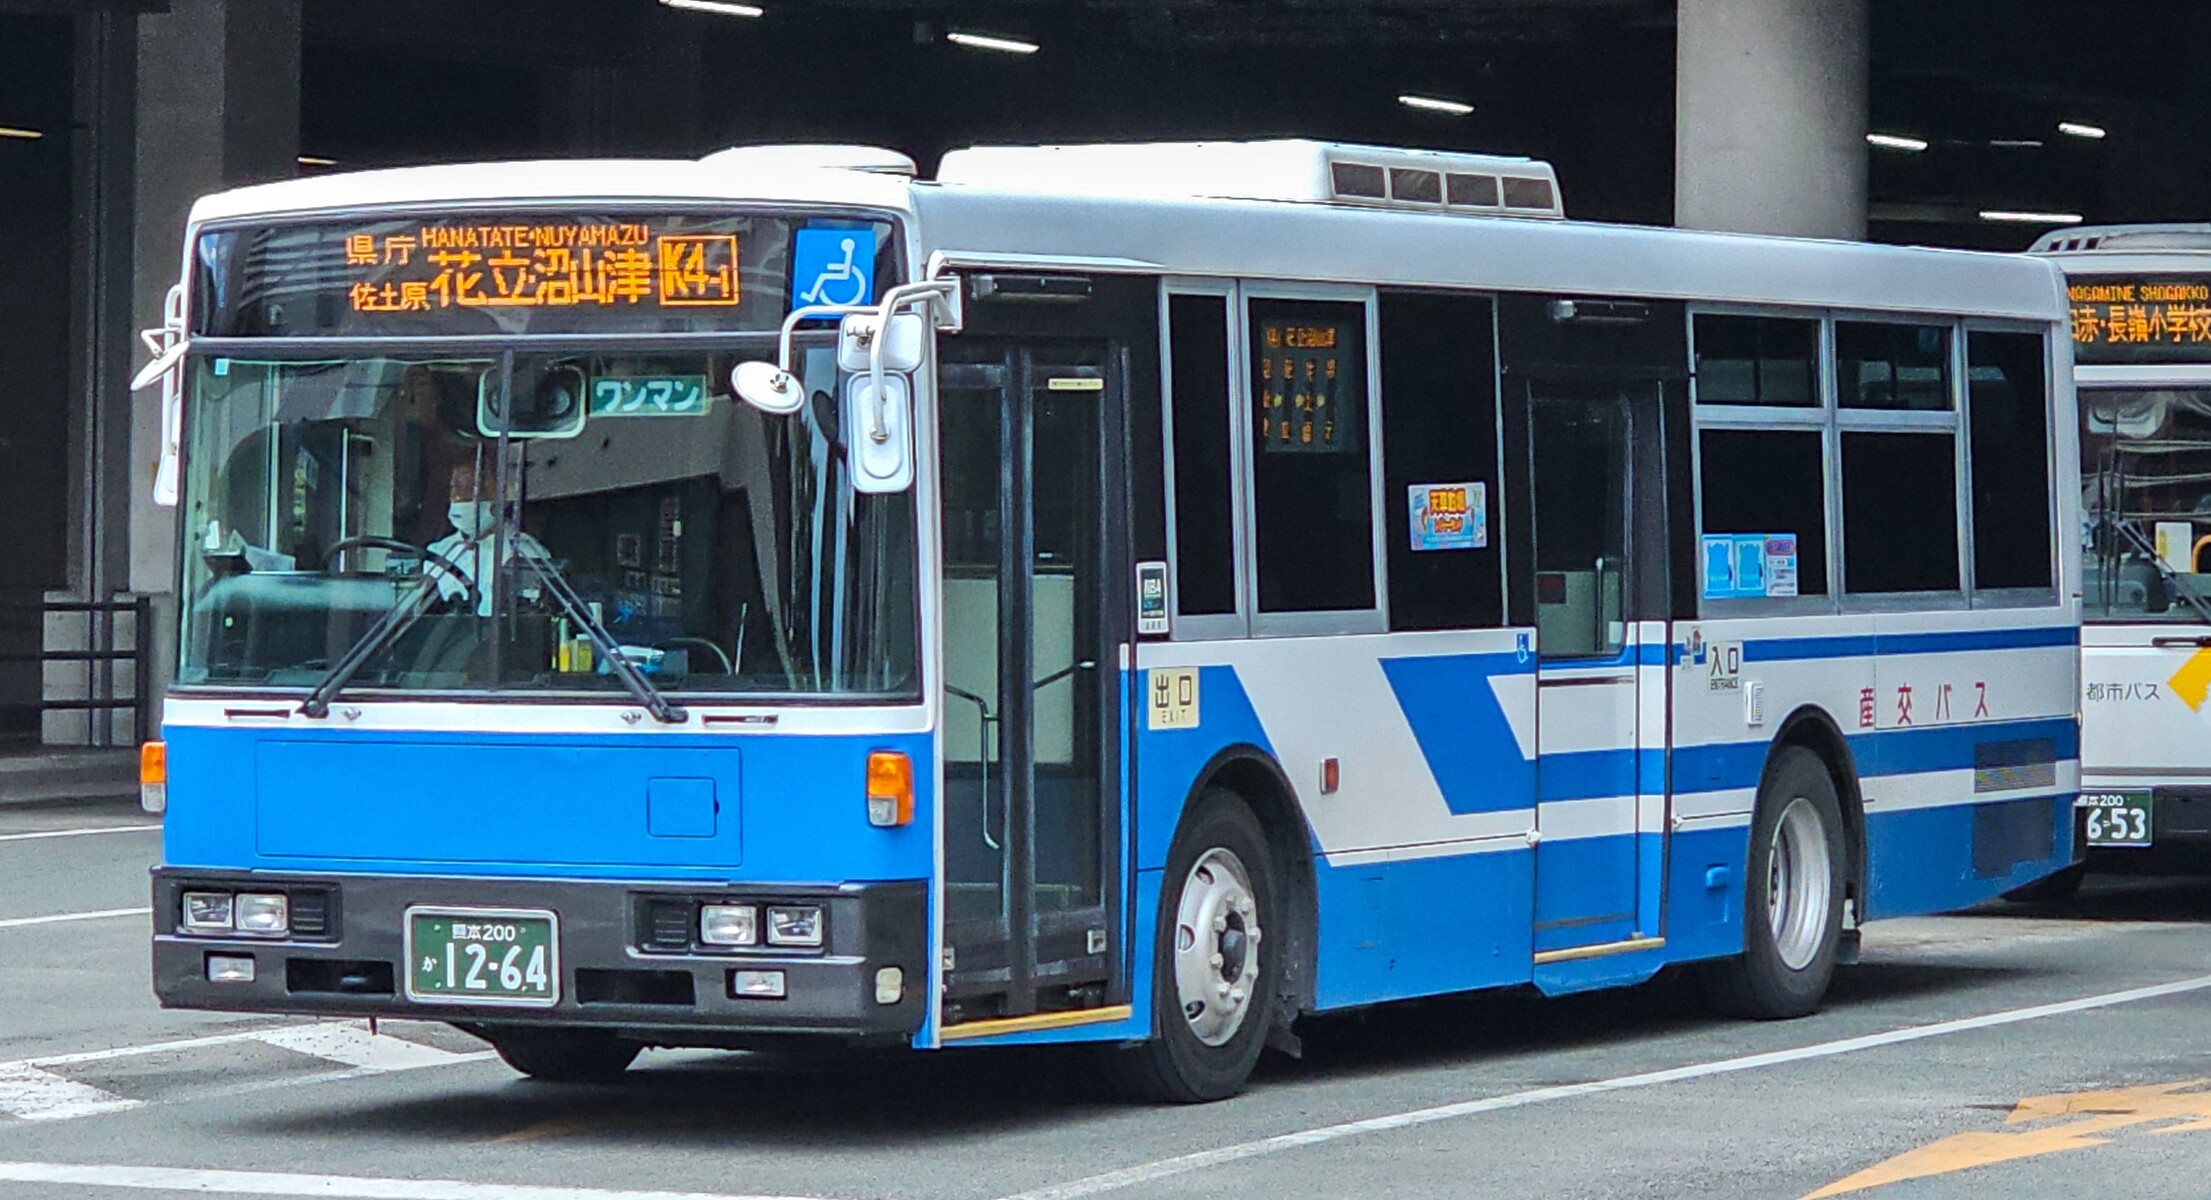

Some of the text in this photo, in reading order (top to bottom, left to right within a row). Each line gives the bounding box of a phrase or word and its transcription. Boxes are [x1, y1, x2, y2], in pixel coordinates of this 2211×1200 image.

[345, 234, 417, 266] 県庁
[428, 247, 652, 308] 花立沼山津
[349, 280, 431, 312] 佐土原
[596, 380, 700, 412] ワンマン
[1710, 645, 1739, 677] 入口
[1154, 673, 1193, 709] 出口
[1859, 681, 1989, 728] 産交バス
[2085, 682, 2160, 702] 都市バス
[1161, 709, 1188, 724] EXIT
[421, 956, 437, 972] か
[446, 942, 547, 991] 12-64
